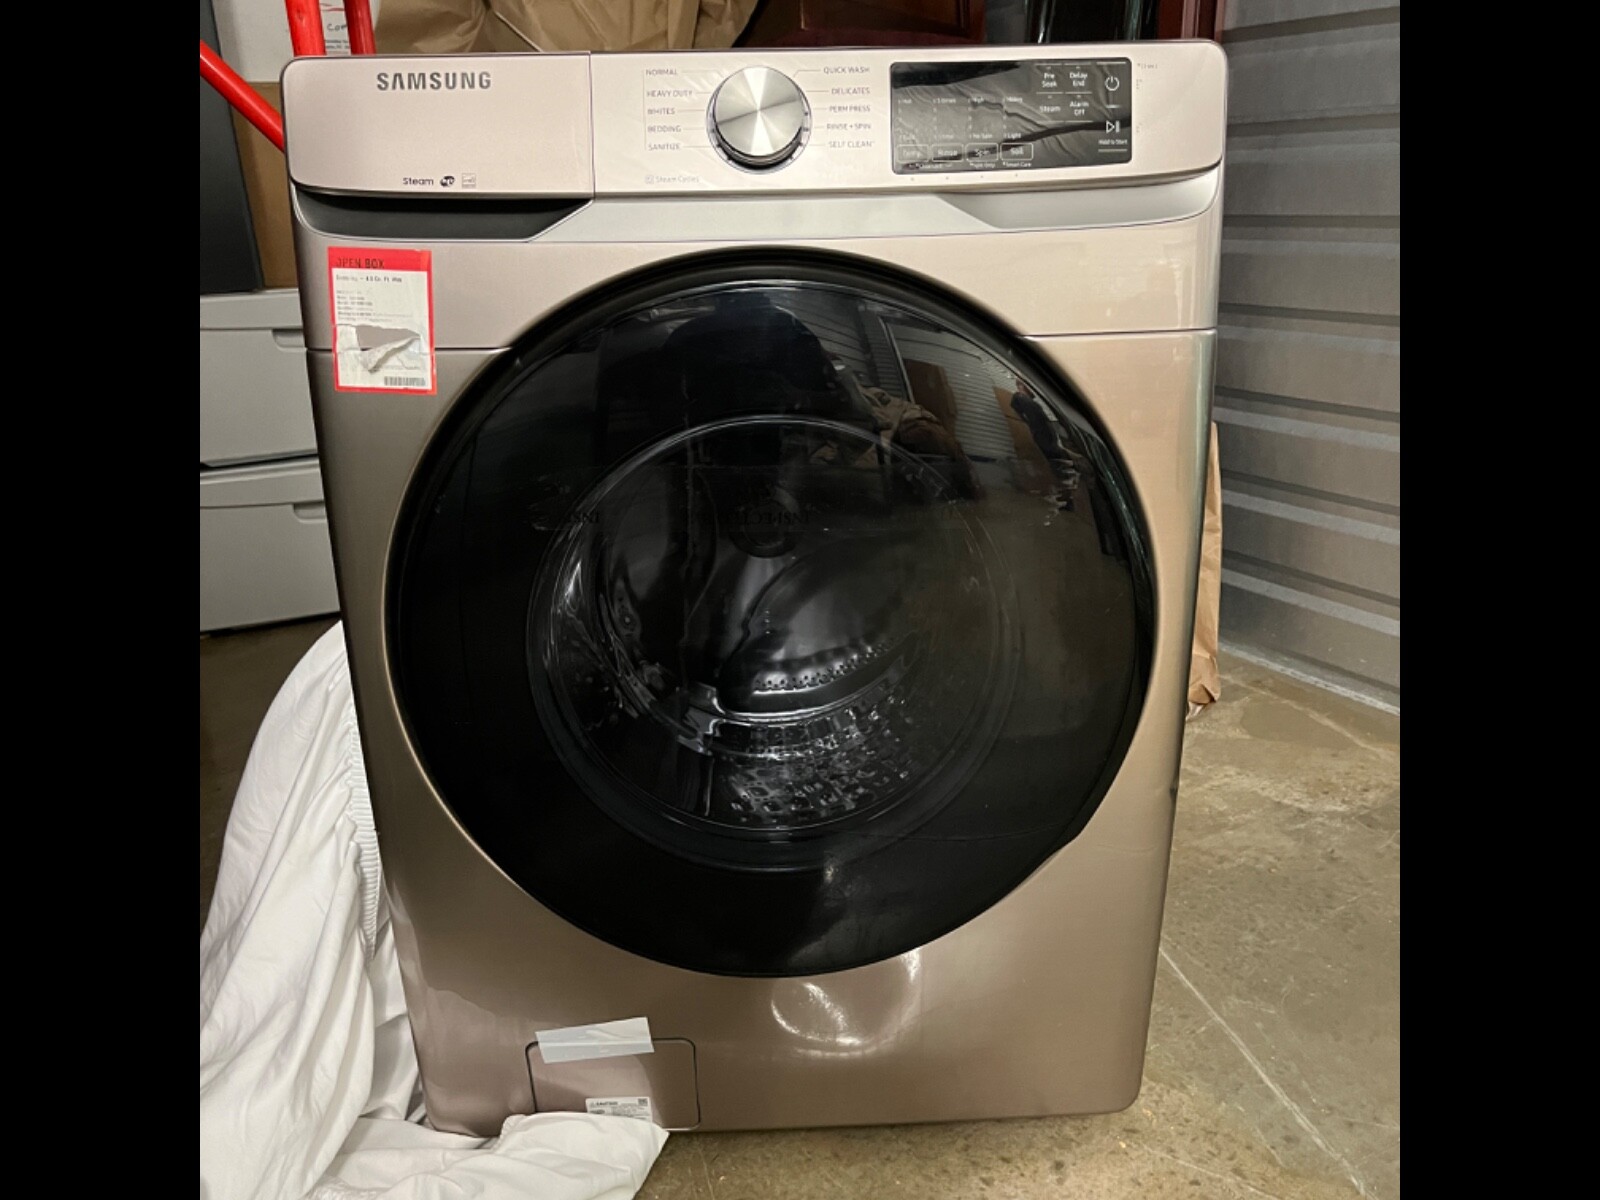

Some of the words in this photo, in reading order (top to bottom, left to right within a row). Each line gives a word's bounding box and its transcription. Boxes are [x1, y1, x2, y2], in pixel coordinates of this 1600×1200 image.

[376, 71, 492, 91] SAMSUNG
[1070, 72, 1088, 80] Delay
[402, 177, 434, 186] Steam
[365, 258, 384, 269] BOX
